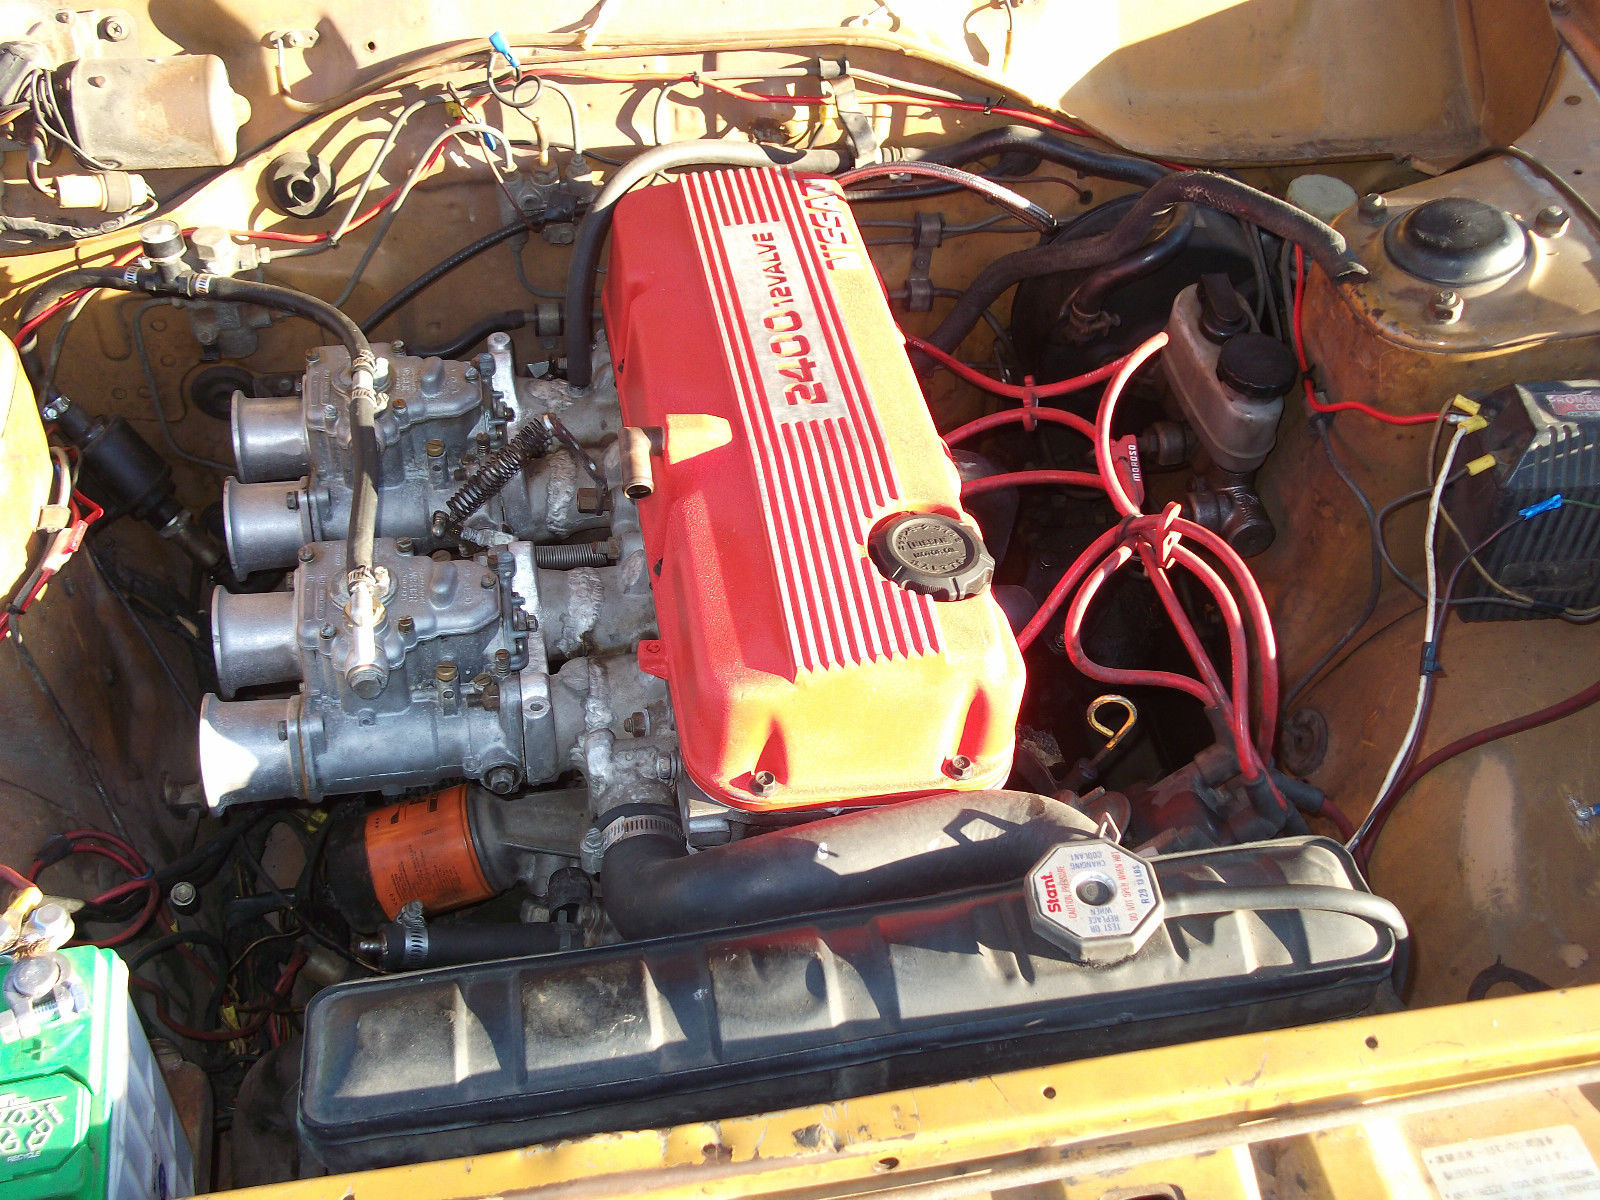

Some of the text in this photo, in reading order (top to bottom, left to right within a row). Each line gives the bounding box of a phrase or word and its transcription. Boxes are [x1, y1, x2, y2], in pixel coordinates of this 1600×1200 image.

[762, 310, 828, 406] 2400
[1070, 851, 1103, 860] COOLANT
[1070, 861, 1106, 870] CHANGING
[1041, 871, 1062, 913] Stant
[1064, 893, 1077, 919] CAUTION
[1090, 908, 1113, 916] WHEN
[1088, 916, 1120, 924] REPLACE
[7, 1151, 41, 1162] RECYCLE
